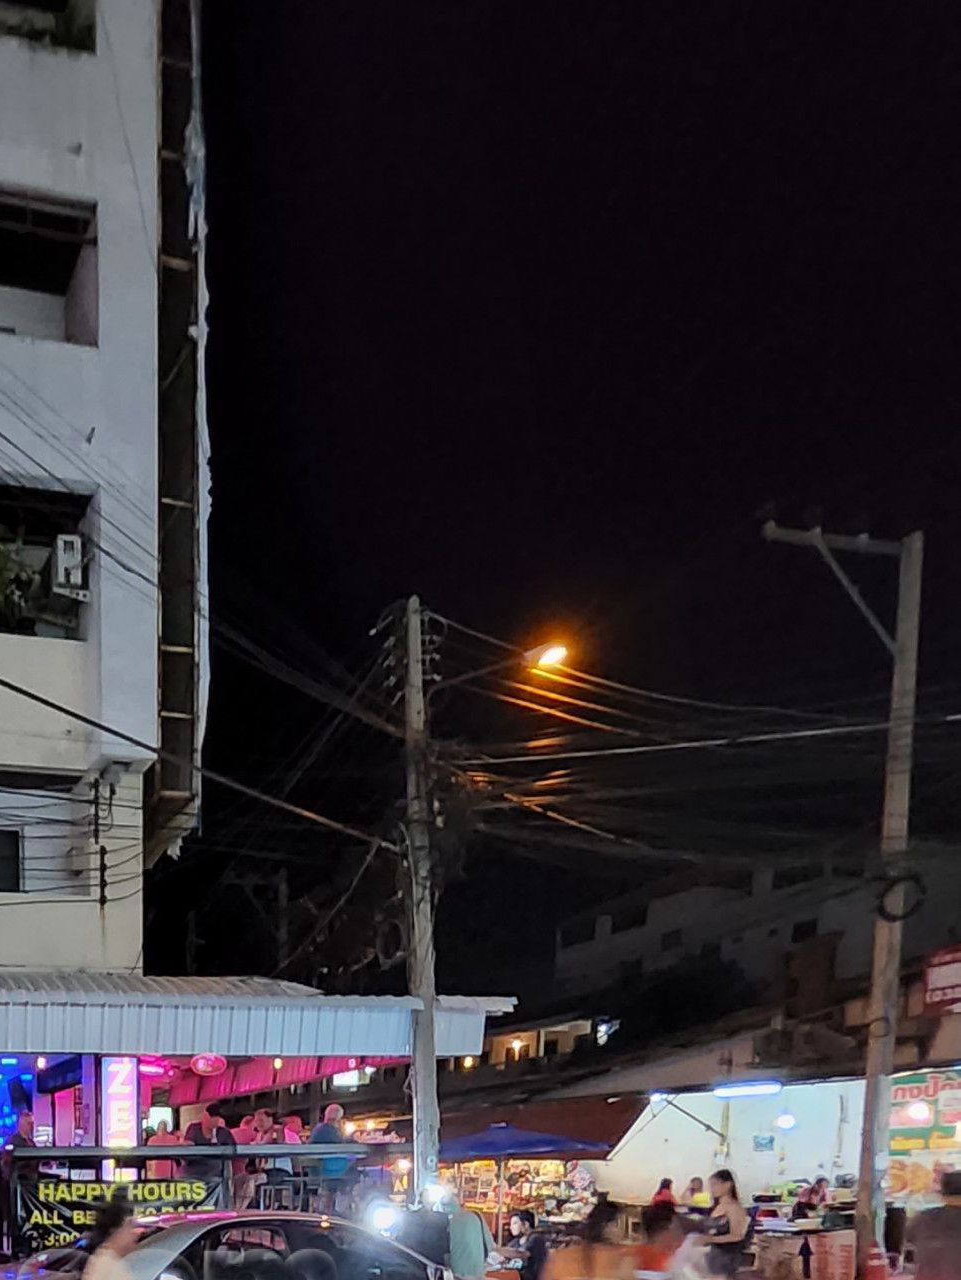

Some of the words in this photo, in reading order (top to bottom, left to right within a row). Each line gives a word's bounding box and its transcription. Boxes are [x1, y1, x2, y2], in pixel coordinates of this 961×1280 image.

[38, 1182, 116, 1202] HAPPY
[127, 1181, 207, 1201] HOURS
[30, 1210, 63, 1225] ALL
